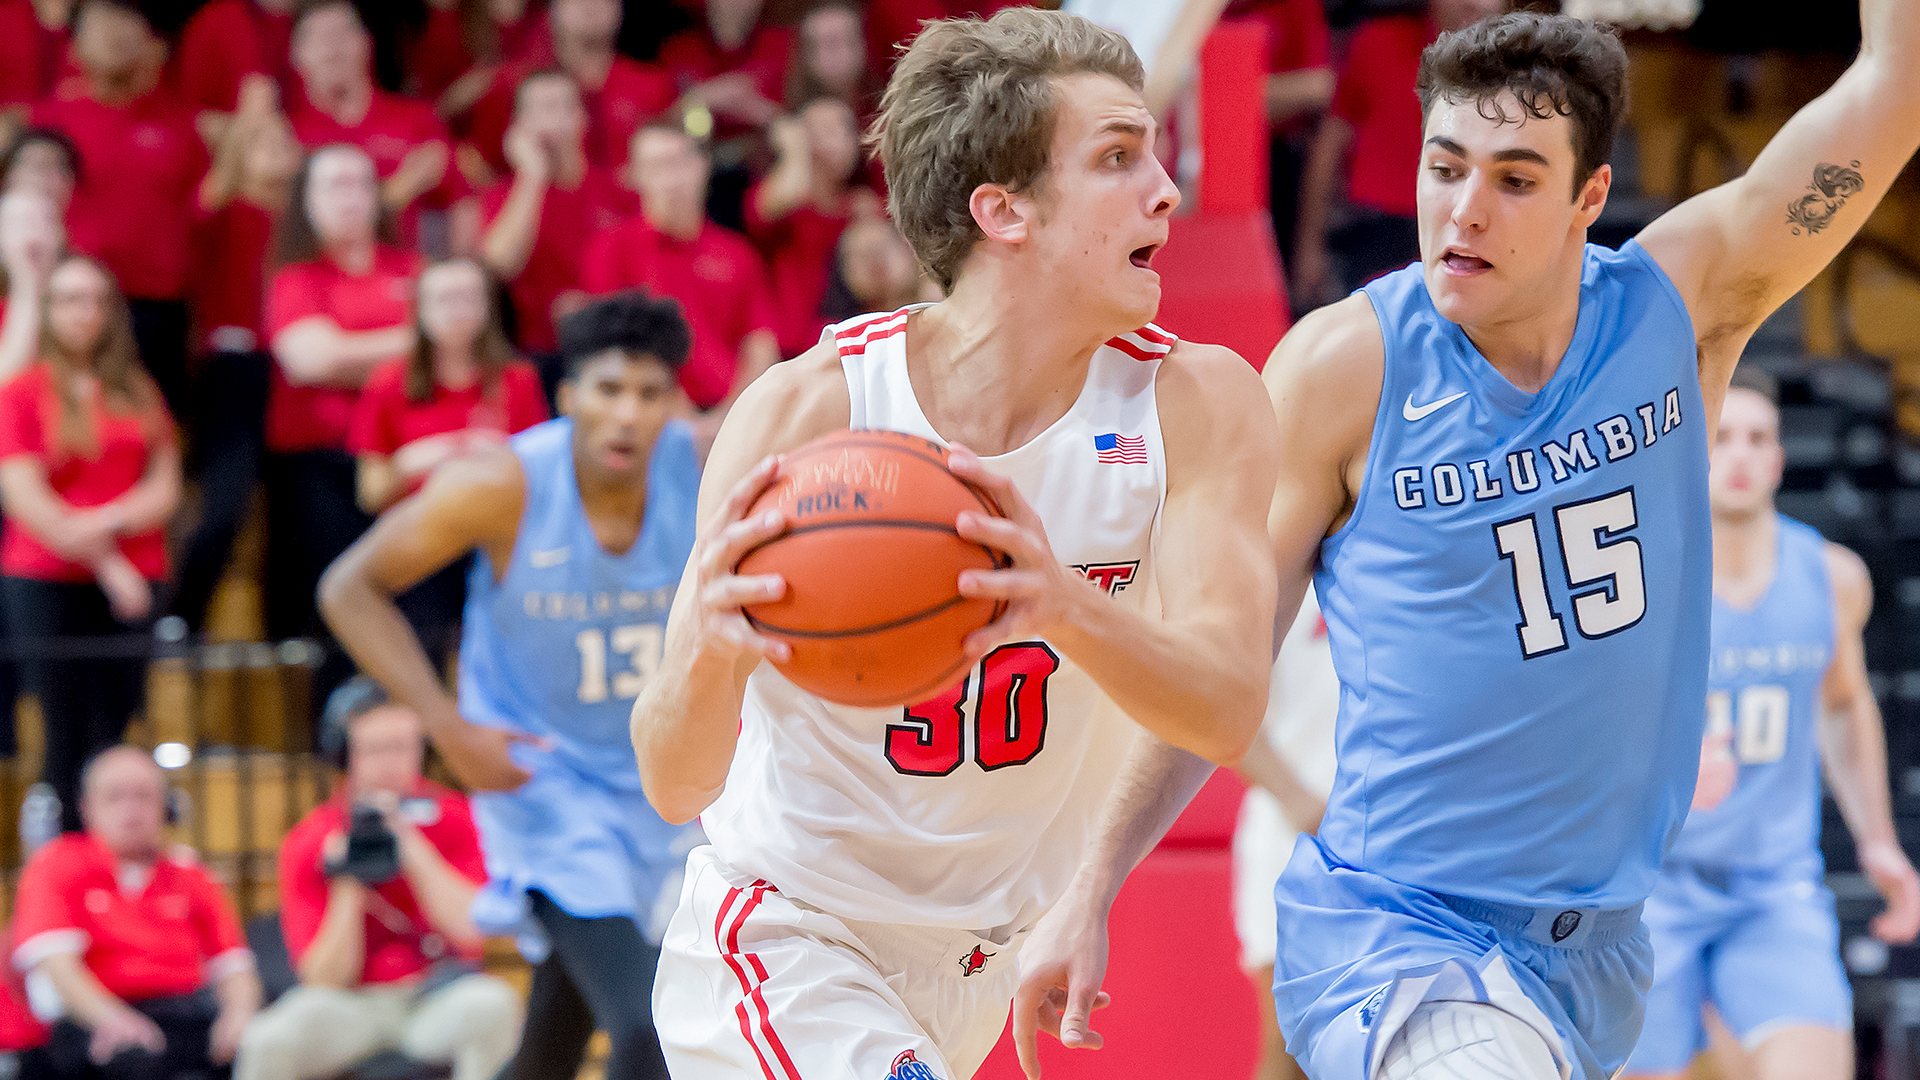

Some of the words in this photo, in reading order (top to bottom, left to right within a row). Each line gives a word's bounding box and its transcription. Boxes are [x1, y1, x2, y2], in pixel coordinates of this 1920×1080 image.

[1393, 386, 1682, 510] COLUMBIA
[1491, 485, 1648, 661] 15
[575, 622, 664, 703] 13
[883, 641, 1060, 777] 30
